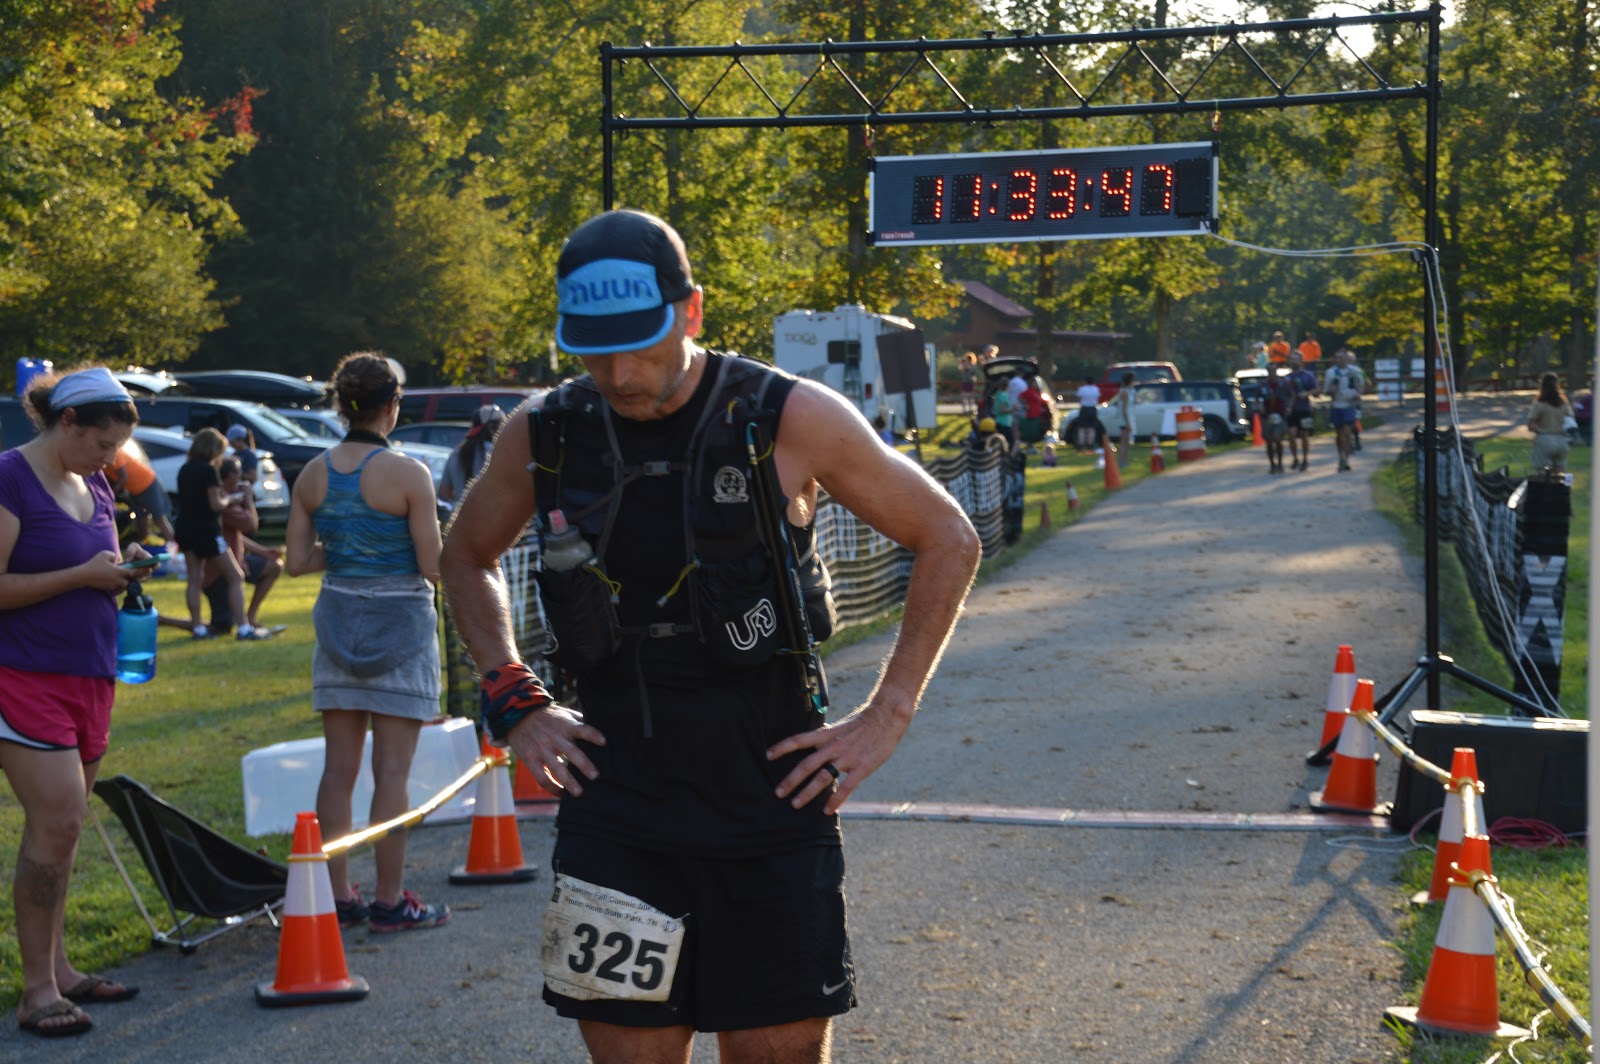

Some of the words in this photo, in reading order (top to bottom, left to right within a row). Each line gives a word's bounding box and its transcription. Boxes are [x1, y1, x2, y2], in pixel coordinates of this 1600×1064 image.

[932, 163, 1173, 222] 11:33:47
[569, 279, 654, 305] nuun
[605, 908, 623, 919] State
[568, 922, 669, 991] 325
